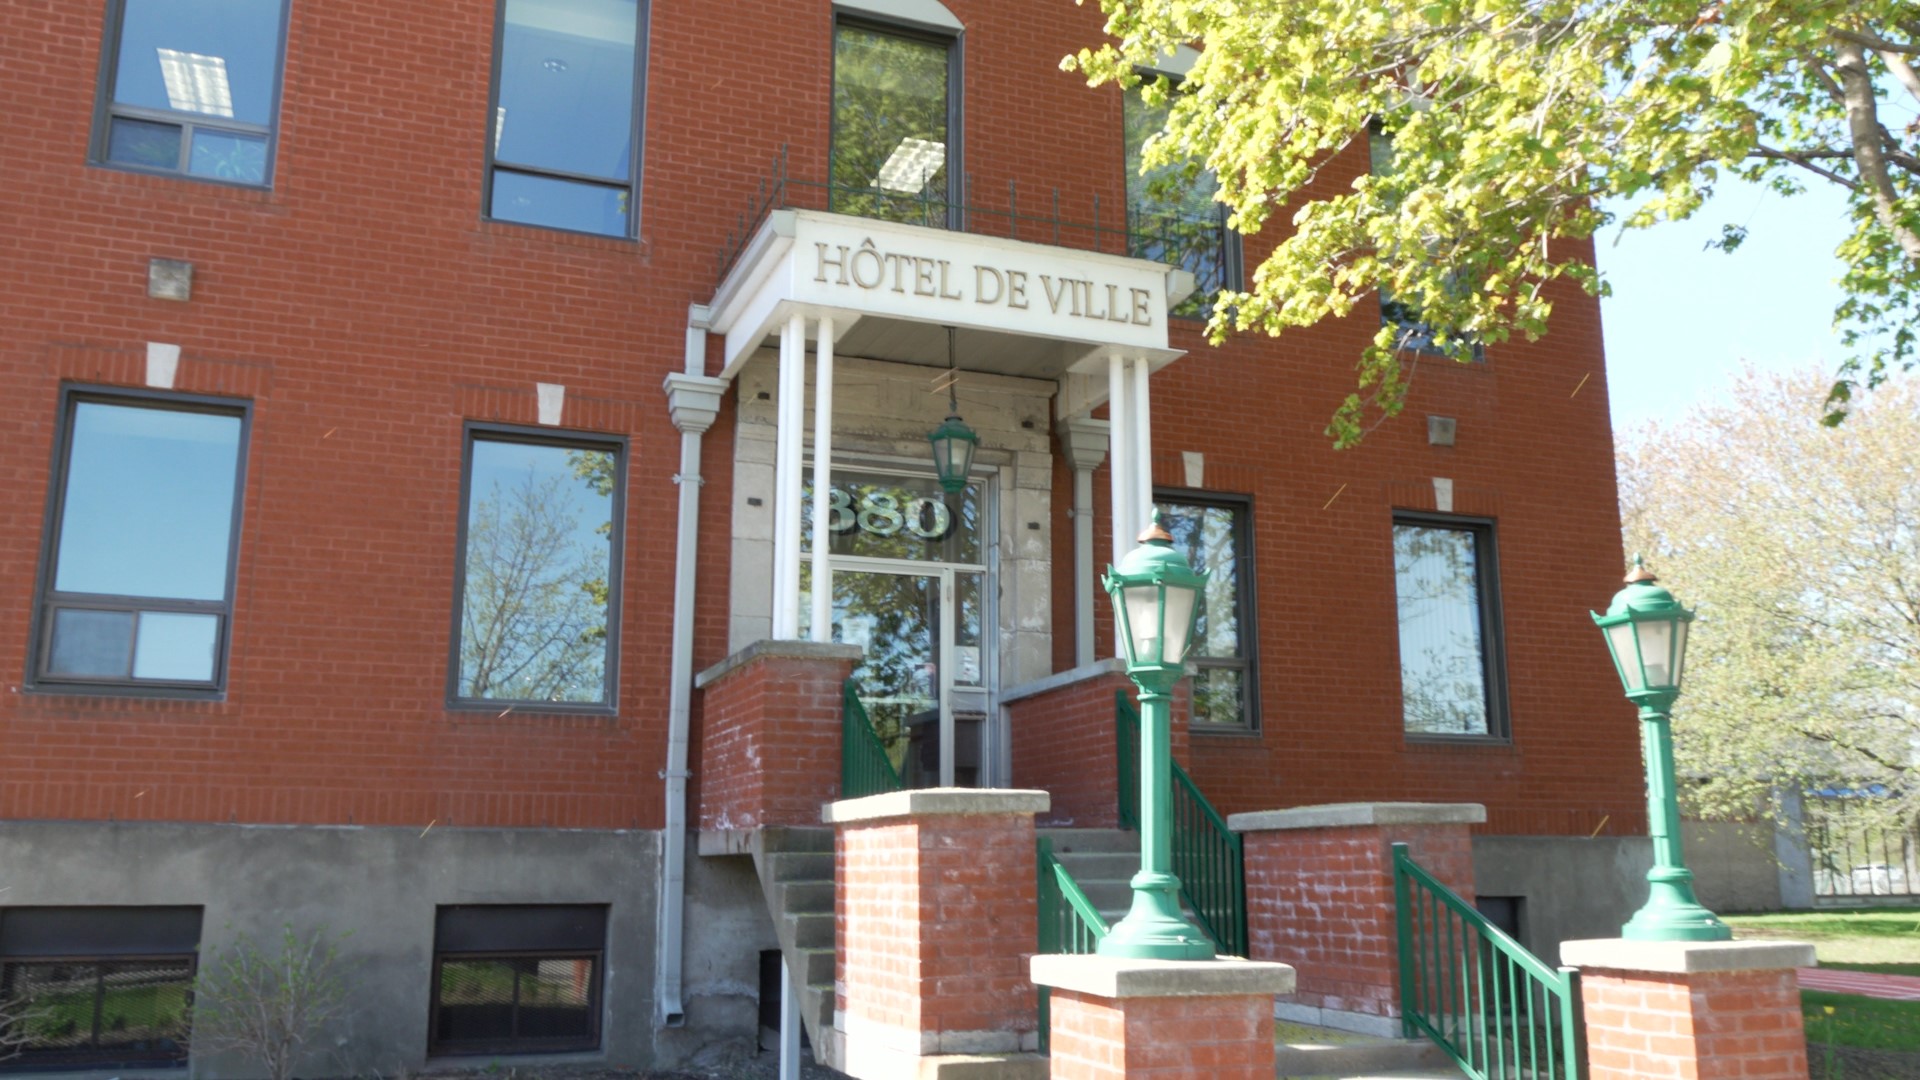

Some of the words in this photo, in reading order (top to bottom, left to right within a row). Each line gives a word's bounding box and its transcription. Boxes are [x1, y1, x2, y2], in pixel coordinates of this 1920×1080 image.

[813, 236, 962, 301] HÔTEL
[973, 265, 1029, 310] DE
[1039, 274, 1152, 326] VILLE
